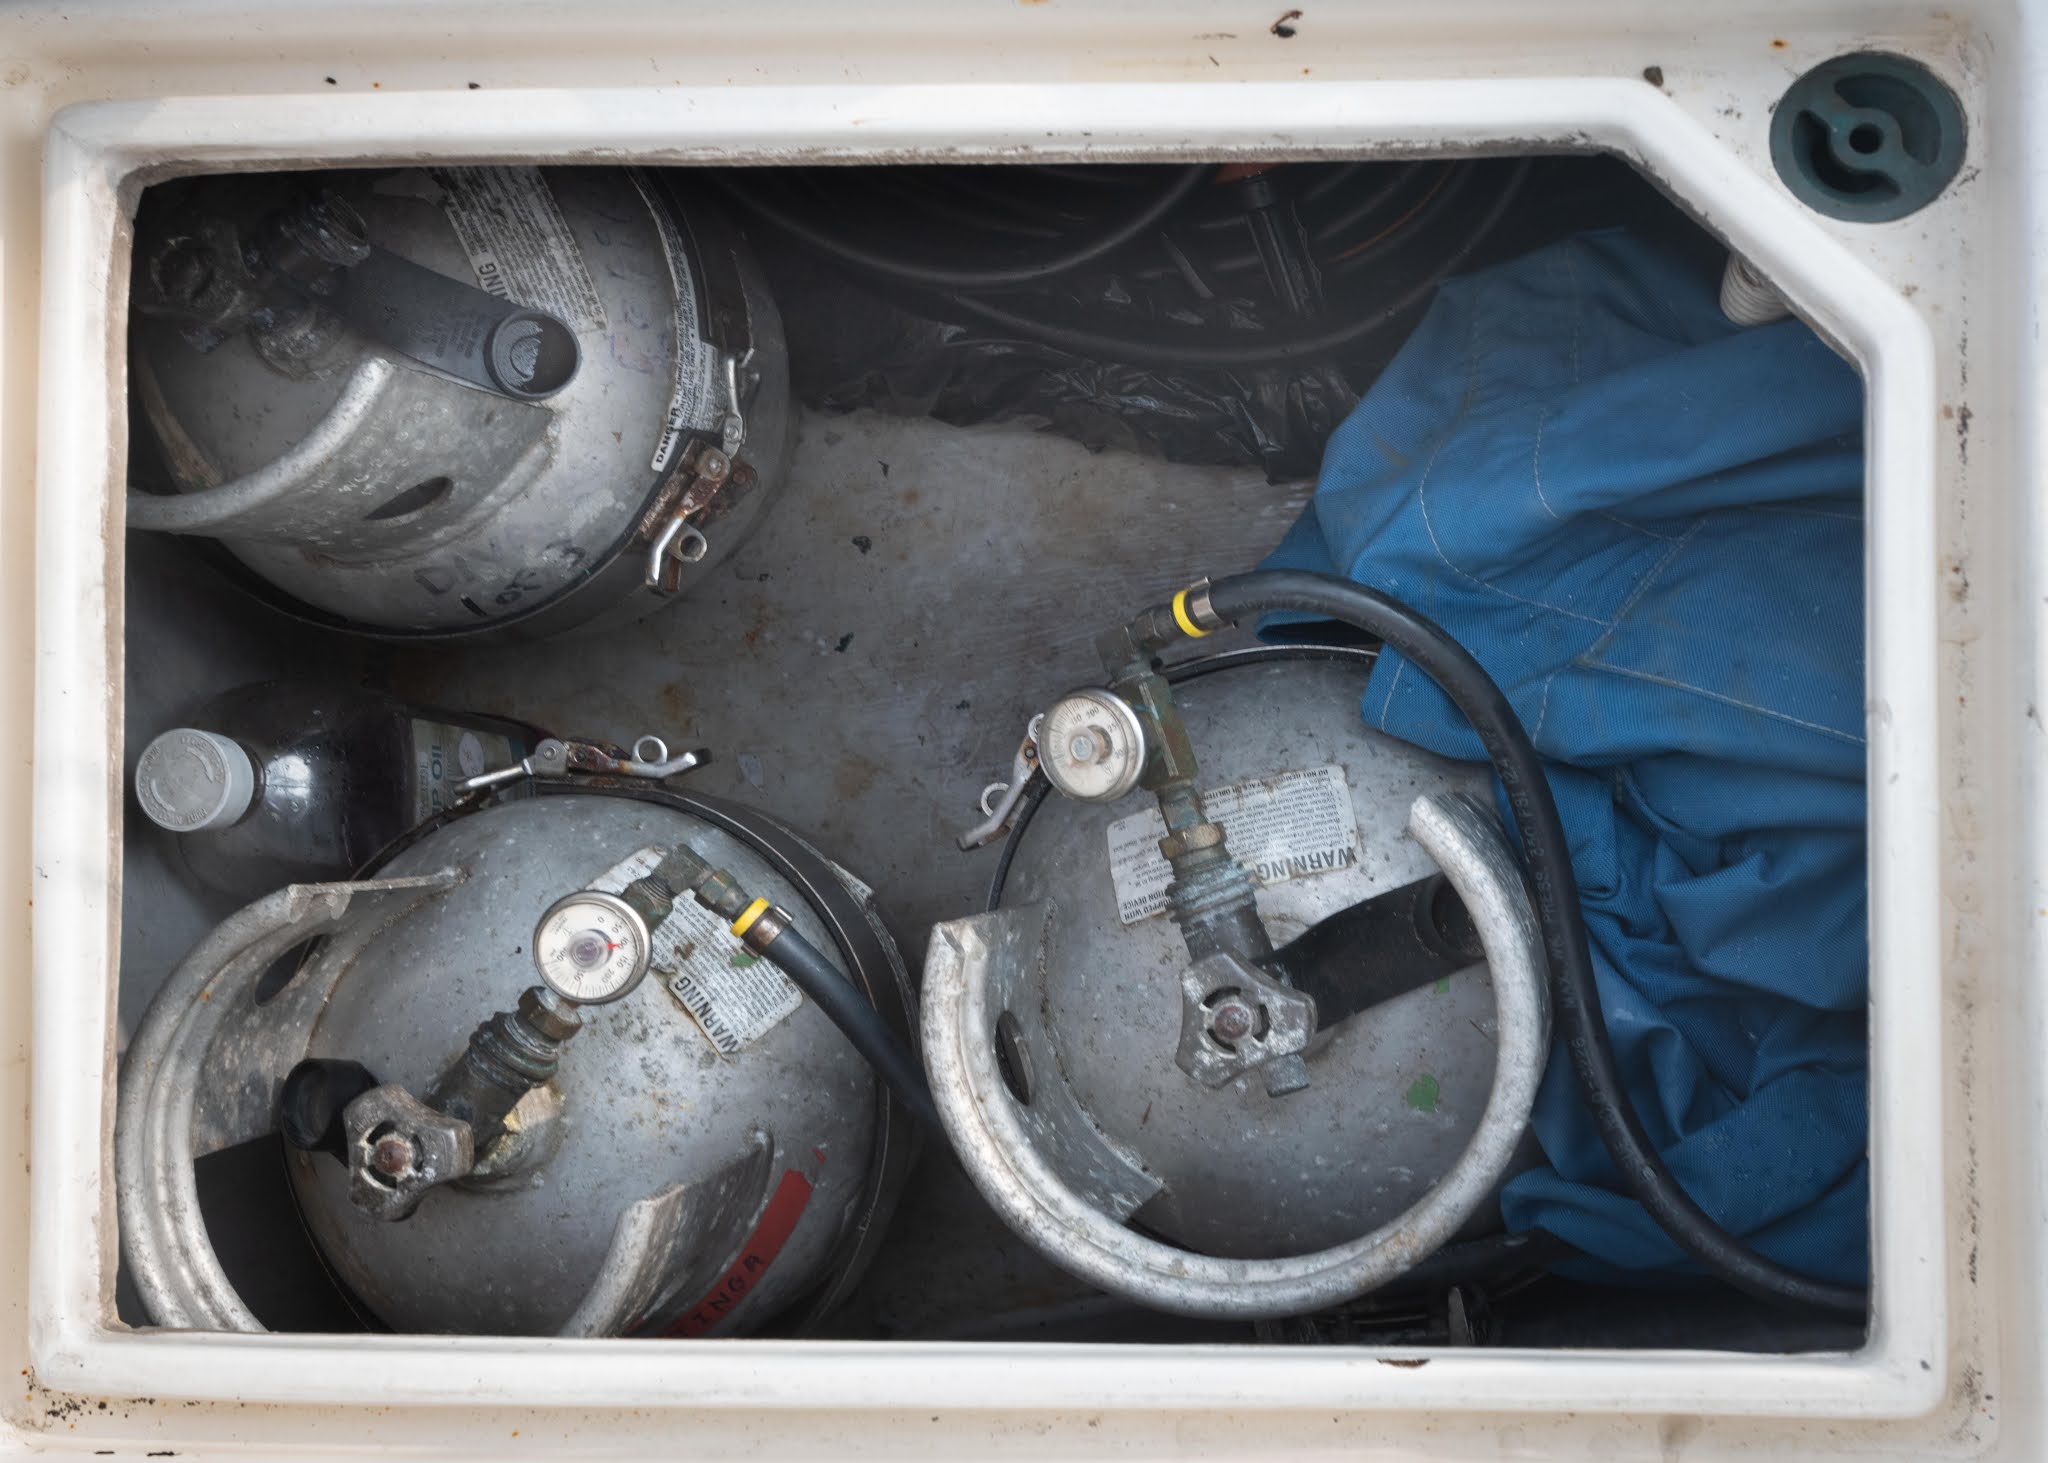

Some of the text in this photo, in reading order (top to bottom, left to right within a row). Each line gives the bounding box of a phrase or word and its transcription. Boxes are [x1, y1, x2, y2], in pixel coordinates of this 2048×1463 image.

[655, 406, 680, 464] DANGER
[1256, 847, 1358, 881] WARNING
[674, 977, 738, 1053] WARNING
